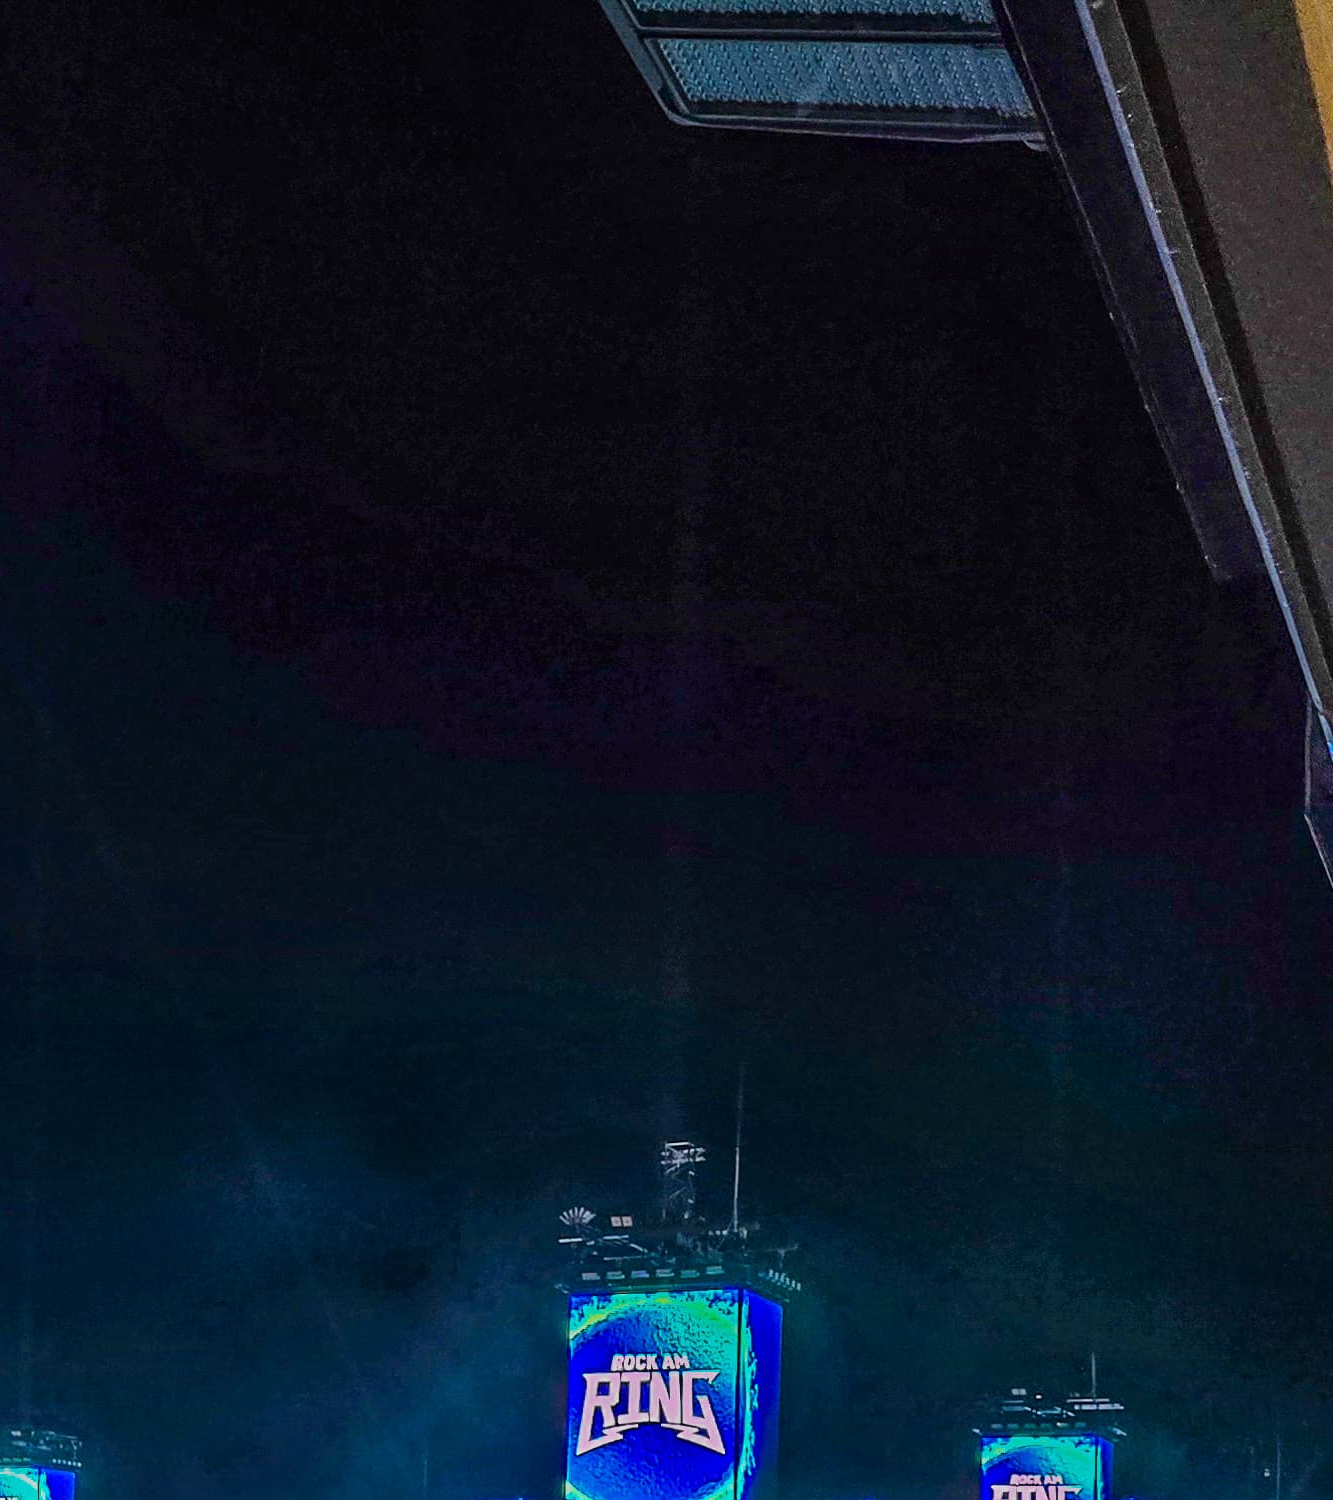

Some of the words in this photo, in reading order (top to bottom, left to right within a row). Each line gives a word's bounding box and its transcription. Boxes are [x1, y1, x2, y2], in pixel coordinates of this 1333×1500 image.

[610, 1353, 658, 1371] ROCK
[662, 1352, 690, 1370] AM
[576, 1368, 726, 1456] RING
